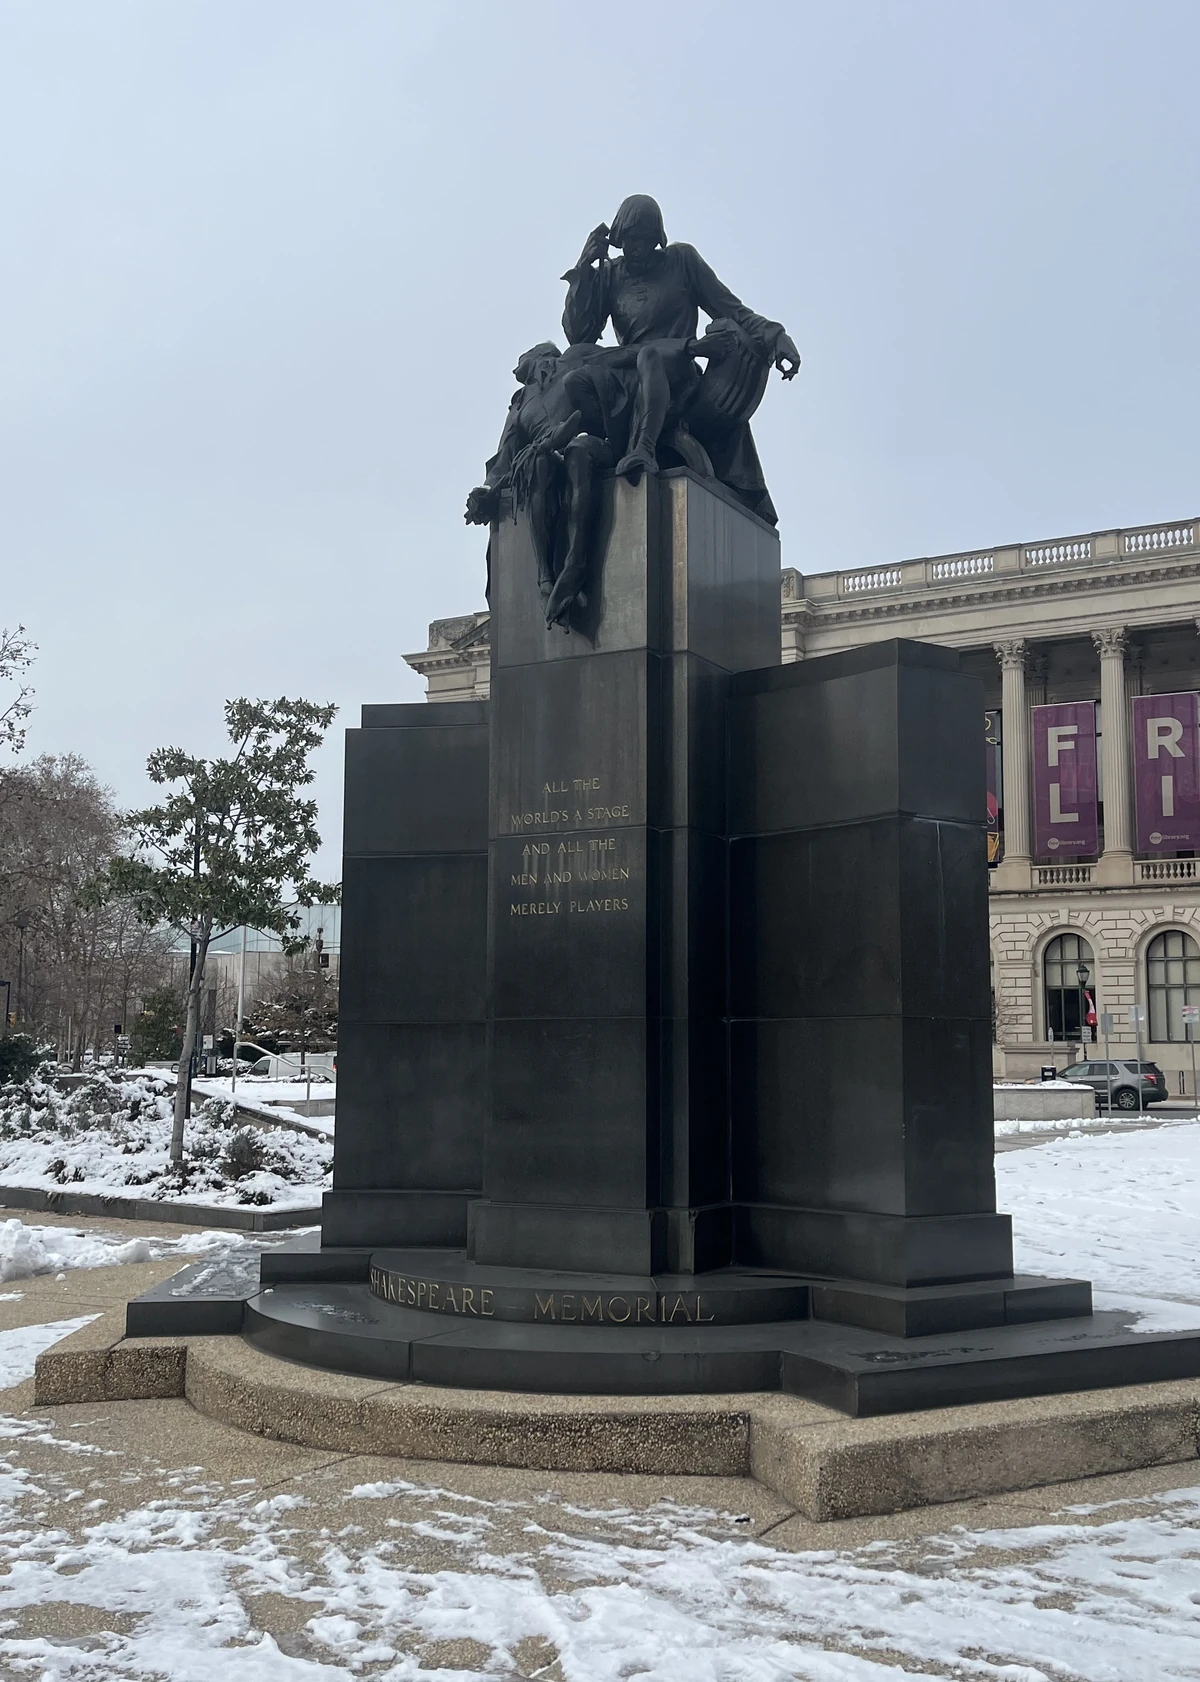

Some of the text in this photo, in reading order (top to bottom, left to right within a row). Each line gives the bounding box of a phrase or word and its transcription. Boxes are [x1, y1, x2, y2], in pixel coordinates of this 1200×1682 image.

[1047, 725, 1078, 767] F
[1146, 717, 1186, 760] R
[542, 778, 600, 794] ALL THE
[574, 810, 582, 820] A
[588, 805, 629, 819] STAGE
[1049, 783, 1079, 824] L
[522, 838, 616, 856] AND ALL THE
[511, 868, 629, 886] MEN AND WOMEN
[510, 898, 628, 916] MERELY PLAYERS
[370, 1268, 715, 1323] SHAKESPEARE MEMORIAL
